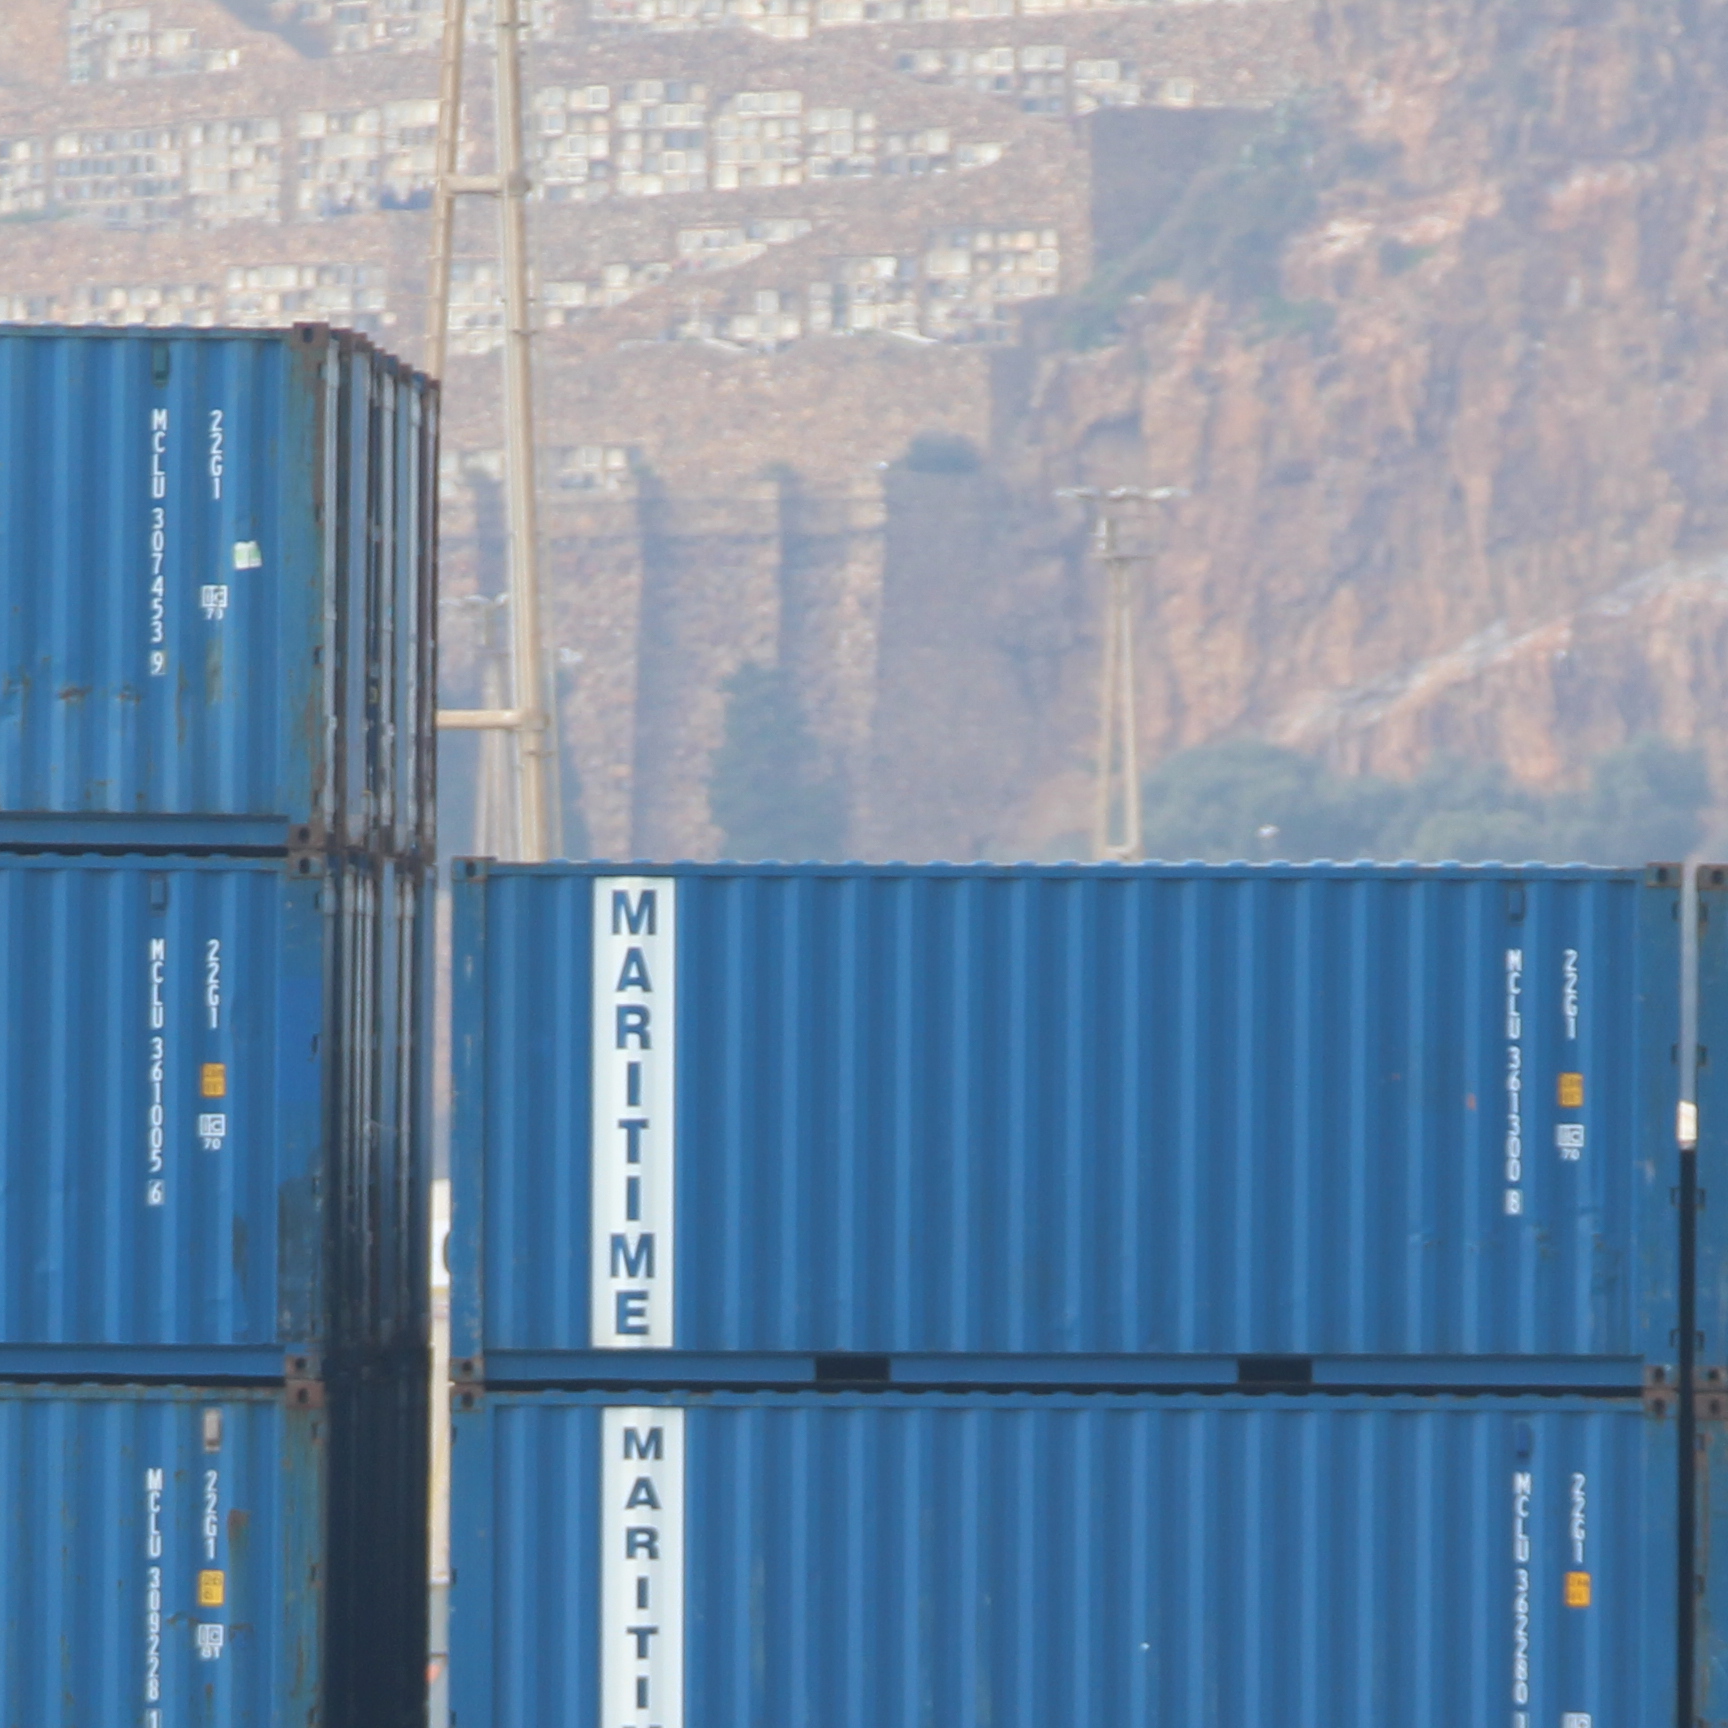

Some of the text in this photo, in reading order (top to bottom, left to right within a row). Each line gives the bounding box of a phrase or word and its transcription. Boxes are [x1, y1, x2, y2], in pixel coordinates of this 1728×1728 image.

[211, 411, 224, 500] 22G1
[152, 410, 169, 676] MCLU 307453 9
[208, 940, 221, 1029] 22G1
[1507, 950, 1523, 1040] MCLU
[1564, 950, 1579, 1040] 22G1
[149, 940, 166, 1207] MCLU 361005 6
[610, 889, 657, 1337] MARITIME
[1507, 1047, 1522, 1183] 361300
[203, 1138, 224, 1151] 70
[147, 1469, 164, 1559] MCLU
[204, 1471, 219, 1560] 22G1
[1515, 1474, 1532, 1564] MCLU
[1572, 1474, 1586, 1564] 22G1
[148, 1568, 162, 1703] 309228
[1514, 1570, 1530, 1706] 362280
